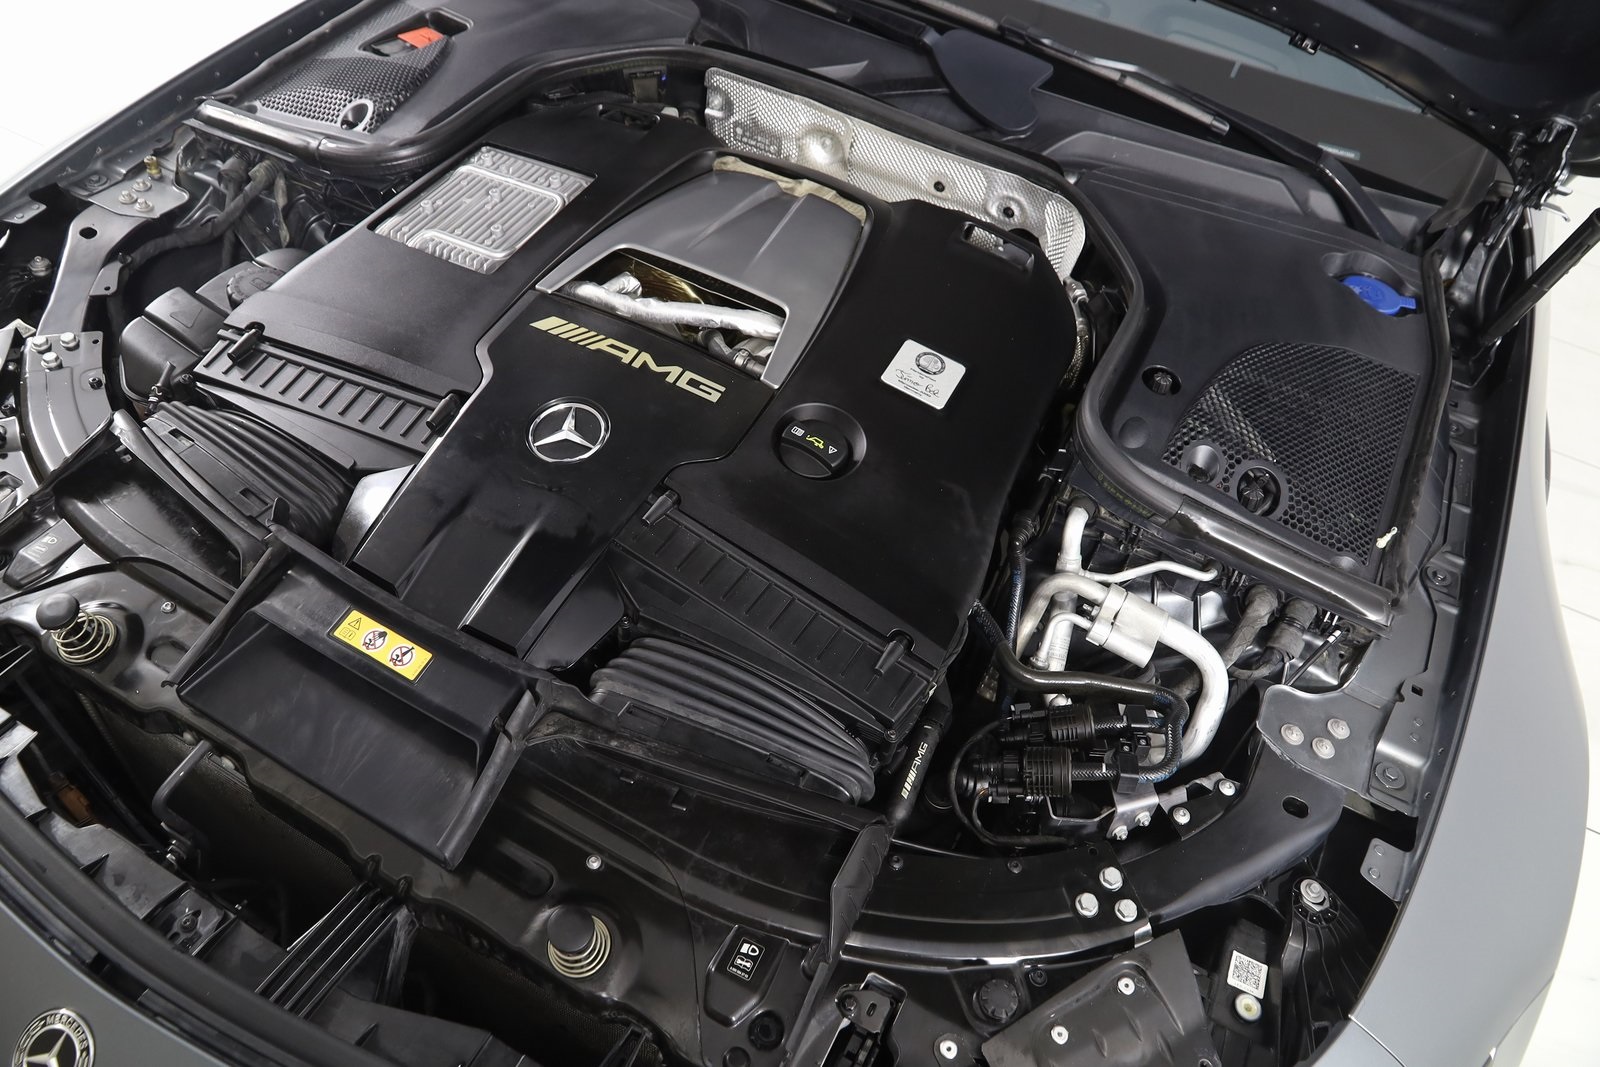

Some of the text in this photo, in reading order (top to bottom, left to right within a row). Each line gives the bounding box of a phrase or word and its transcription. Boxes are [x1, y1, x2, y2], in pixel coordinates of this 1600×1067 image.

[585, 335, 727, 403] AMG
[911, 741, 929, 774] AMG
[46, 1012, 89, 1051] MERCEDES
